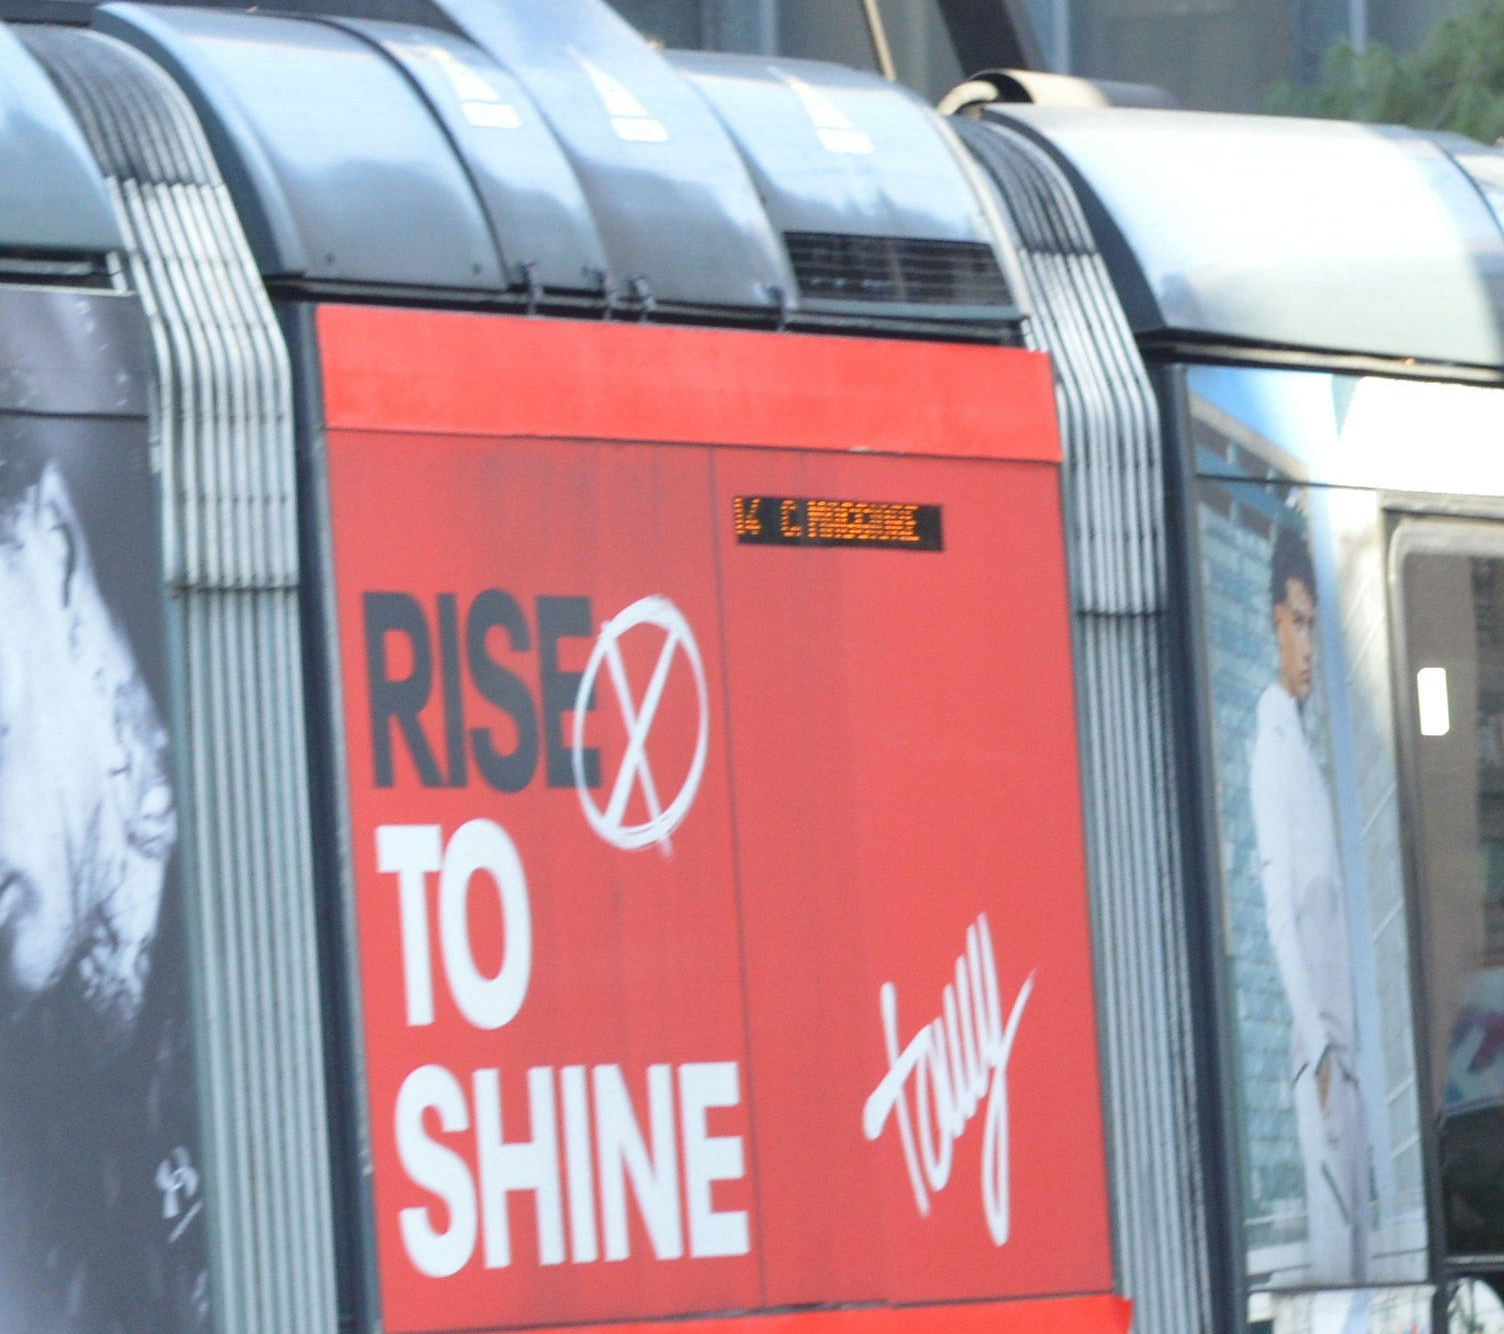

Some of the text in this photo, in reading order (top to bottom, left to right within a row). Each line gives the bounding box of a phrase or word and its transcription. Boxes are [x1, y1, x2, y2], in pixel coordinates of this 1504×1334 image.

[361, 587, 603, 793] RISE
[375, 817, 533, 1030] TO
[393, 1061, 751, 1279] SHINE
